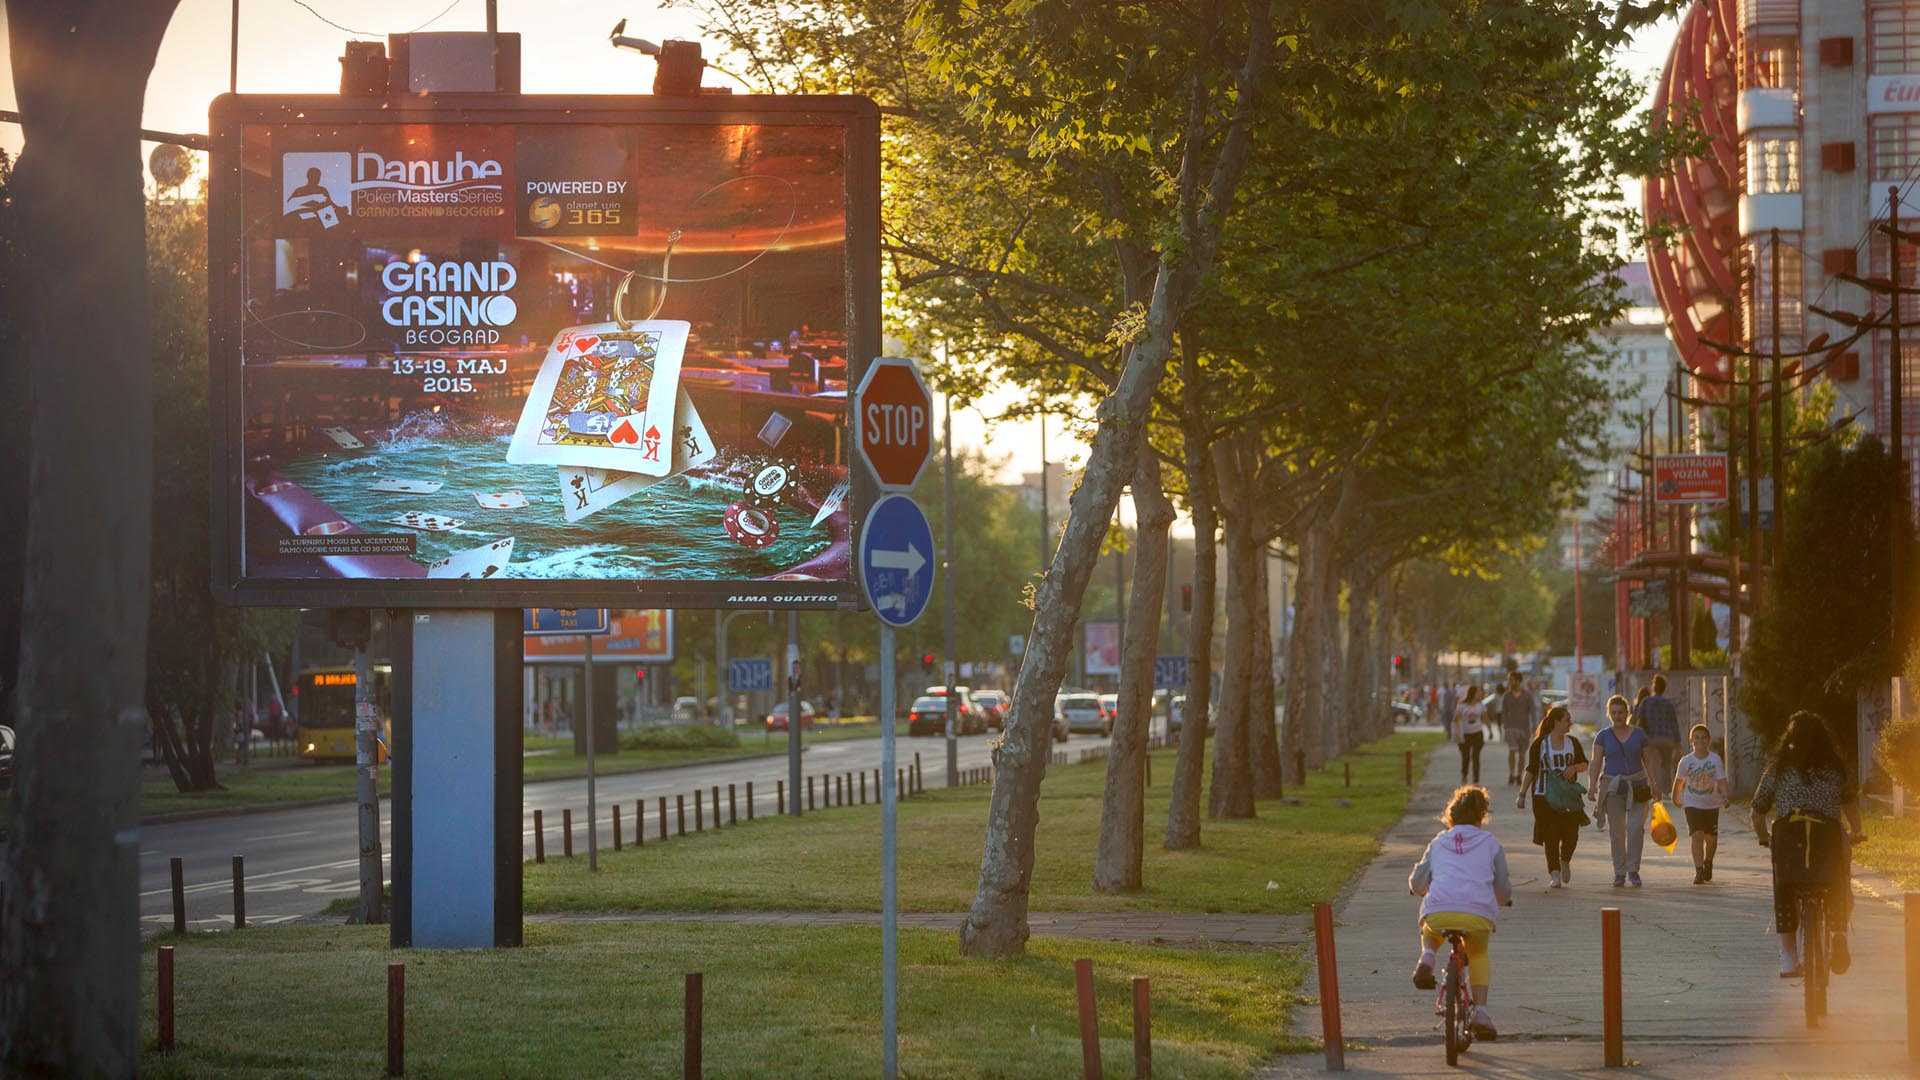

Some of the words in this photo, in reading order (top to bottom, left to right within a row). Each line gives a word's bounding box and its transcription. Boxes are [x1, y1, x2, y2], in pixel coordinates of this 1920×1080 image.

[357, 151, 503, 184] Danube
[527, 181, 603, 194] POWERED
[607, 181, 628, 194] BY
[357, 206, 400, 217] GRAND
[446, 206, 503, 217] BEOGRAD
[568, 209, 621, 225] 365
[382, 261, 517, 292] GRAND
[382, 295, 517, 326] CASINO
[406, 329, 500, 344] BEOGRAD
[392, 358, 451, 375] 13-19.
[456, 359, 507, 374] MAJ
[423, 377, 478, 393] 2015.
[867, 402, 925, 447] STOP
